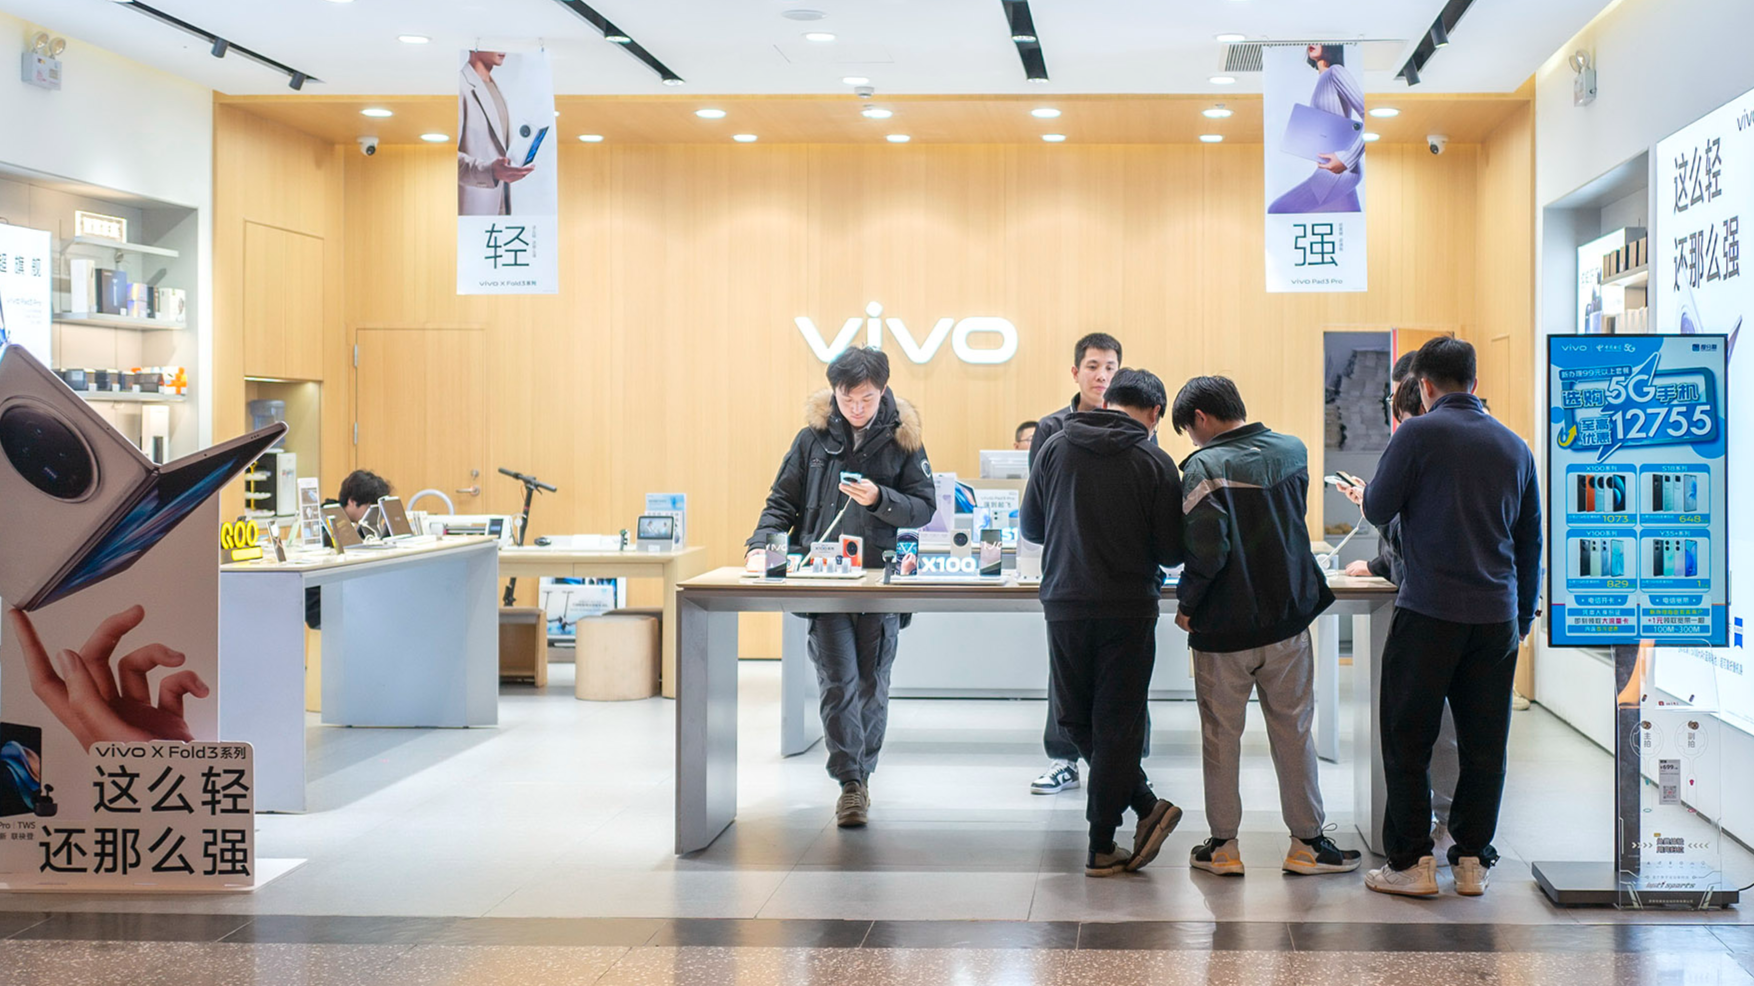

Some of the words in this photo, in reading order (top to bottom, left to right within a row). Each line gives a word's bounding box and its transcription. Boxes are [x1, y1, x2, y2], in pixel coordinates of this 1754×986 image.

[1737, 108, 1754, 131] viv
[1674, 137, 1722, 214] 这么轻
[484, 223, 530, 269] 轻
[1293, 223, 1338, 267] 强
[1674, 215, 1740, 292] 还那么强
[793, 301, 1018, 364] vivo
[1611, 405, 1712, 440] 12755
[1602, 515, 1629, 523] 1073
[1679, 515, 1701, 523] 648
[921, 557, 977, 573] X100
[1606, 580, 1629, 588] 829
[95, 744, 146, 758] vivo
[151, 746, 164, 758] X
[169, 745, 247, 759] Fold3系列
[93, 765, 250, 816] 这么轻
[17, 821, 36, 830] TWS
[39, 826, 251, 877] 还那么强
